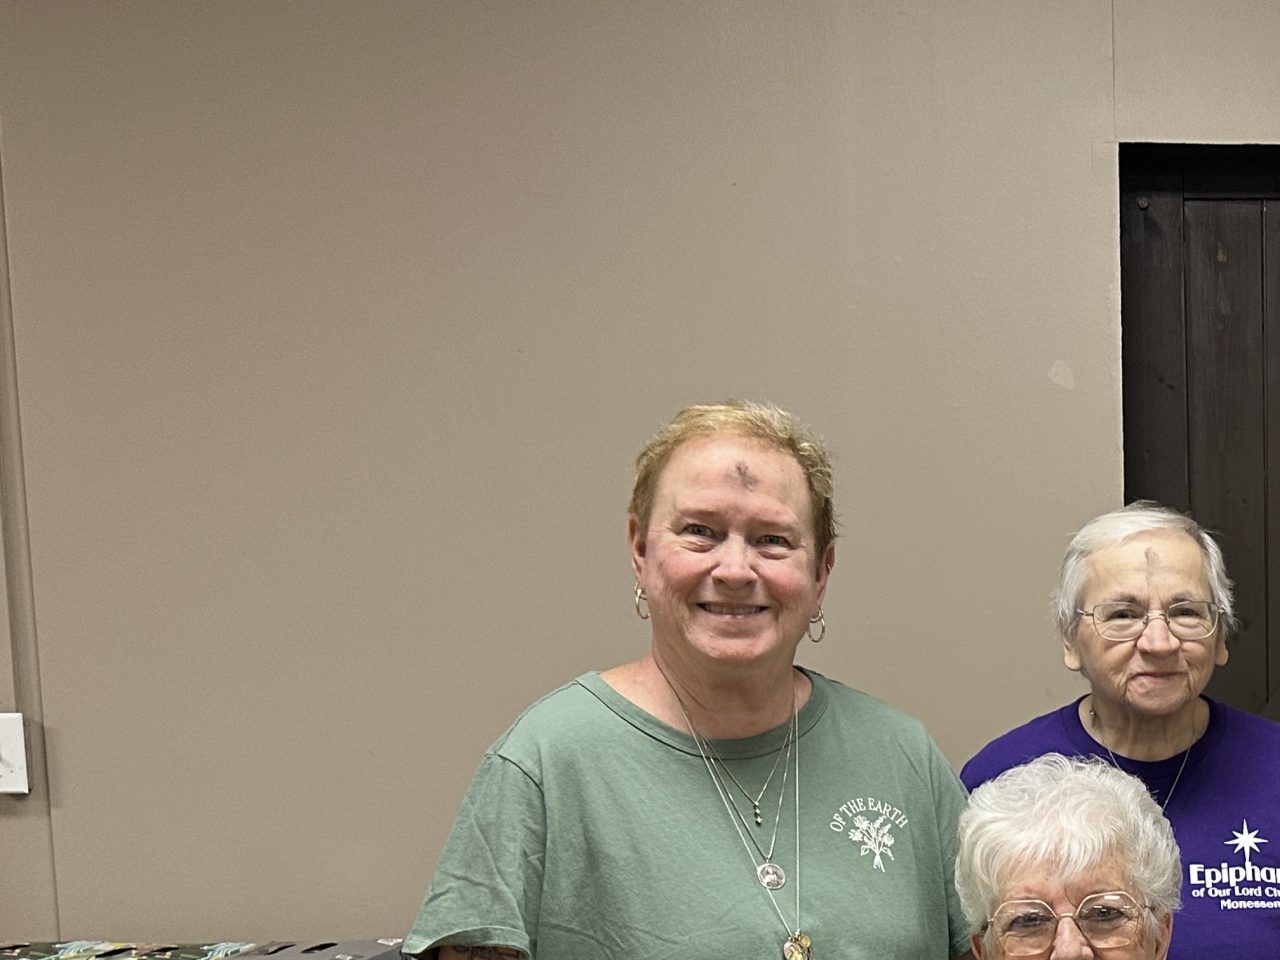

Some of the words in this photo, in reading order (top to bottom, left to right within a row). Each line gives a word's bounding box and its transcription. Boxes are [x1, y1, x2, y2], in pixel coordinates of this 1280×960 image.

[829, 812, 847, 833] OF
[839, 797, 867, 818] THE
[867, 797, 909, 829] EARTH
[1191, 887, 1206, 898] of
[1207, 887, 1231, 898] Our
[1234, 885, 1262, 897] Lord
